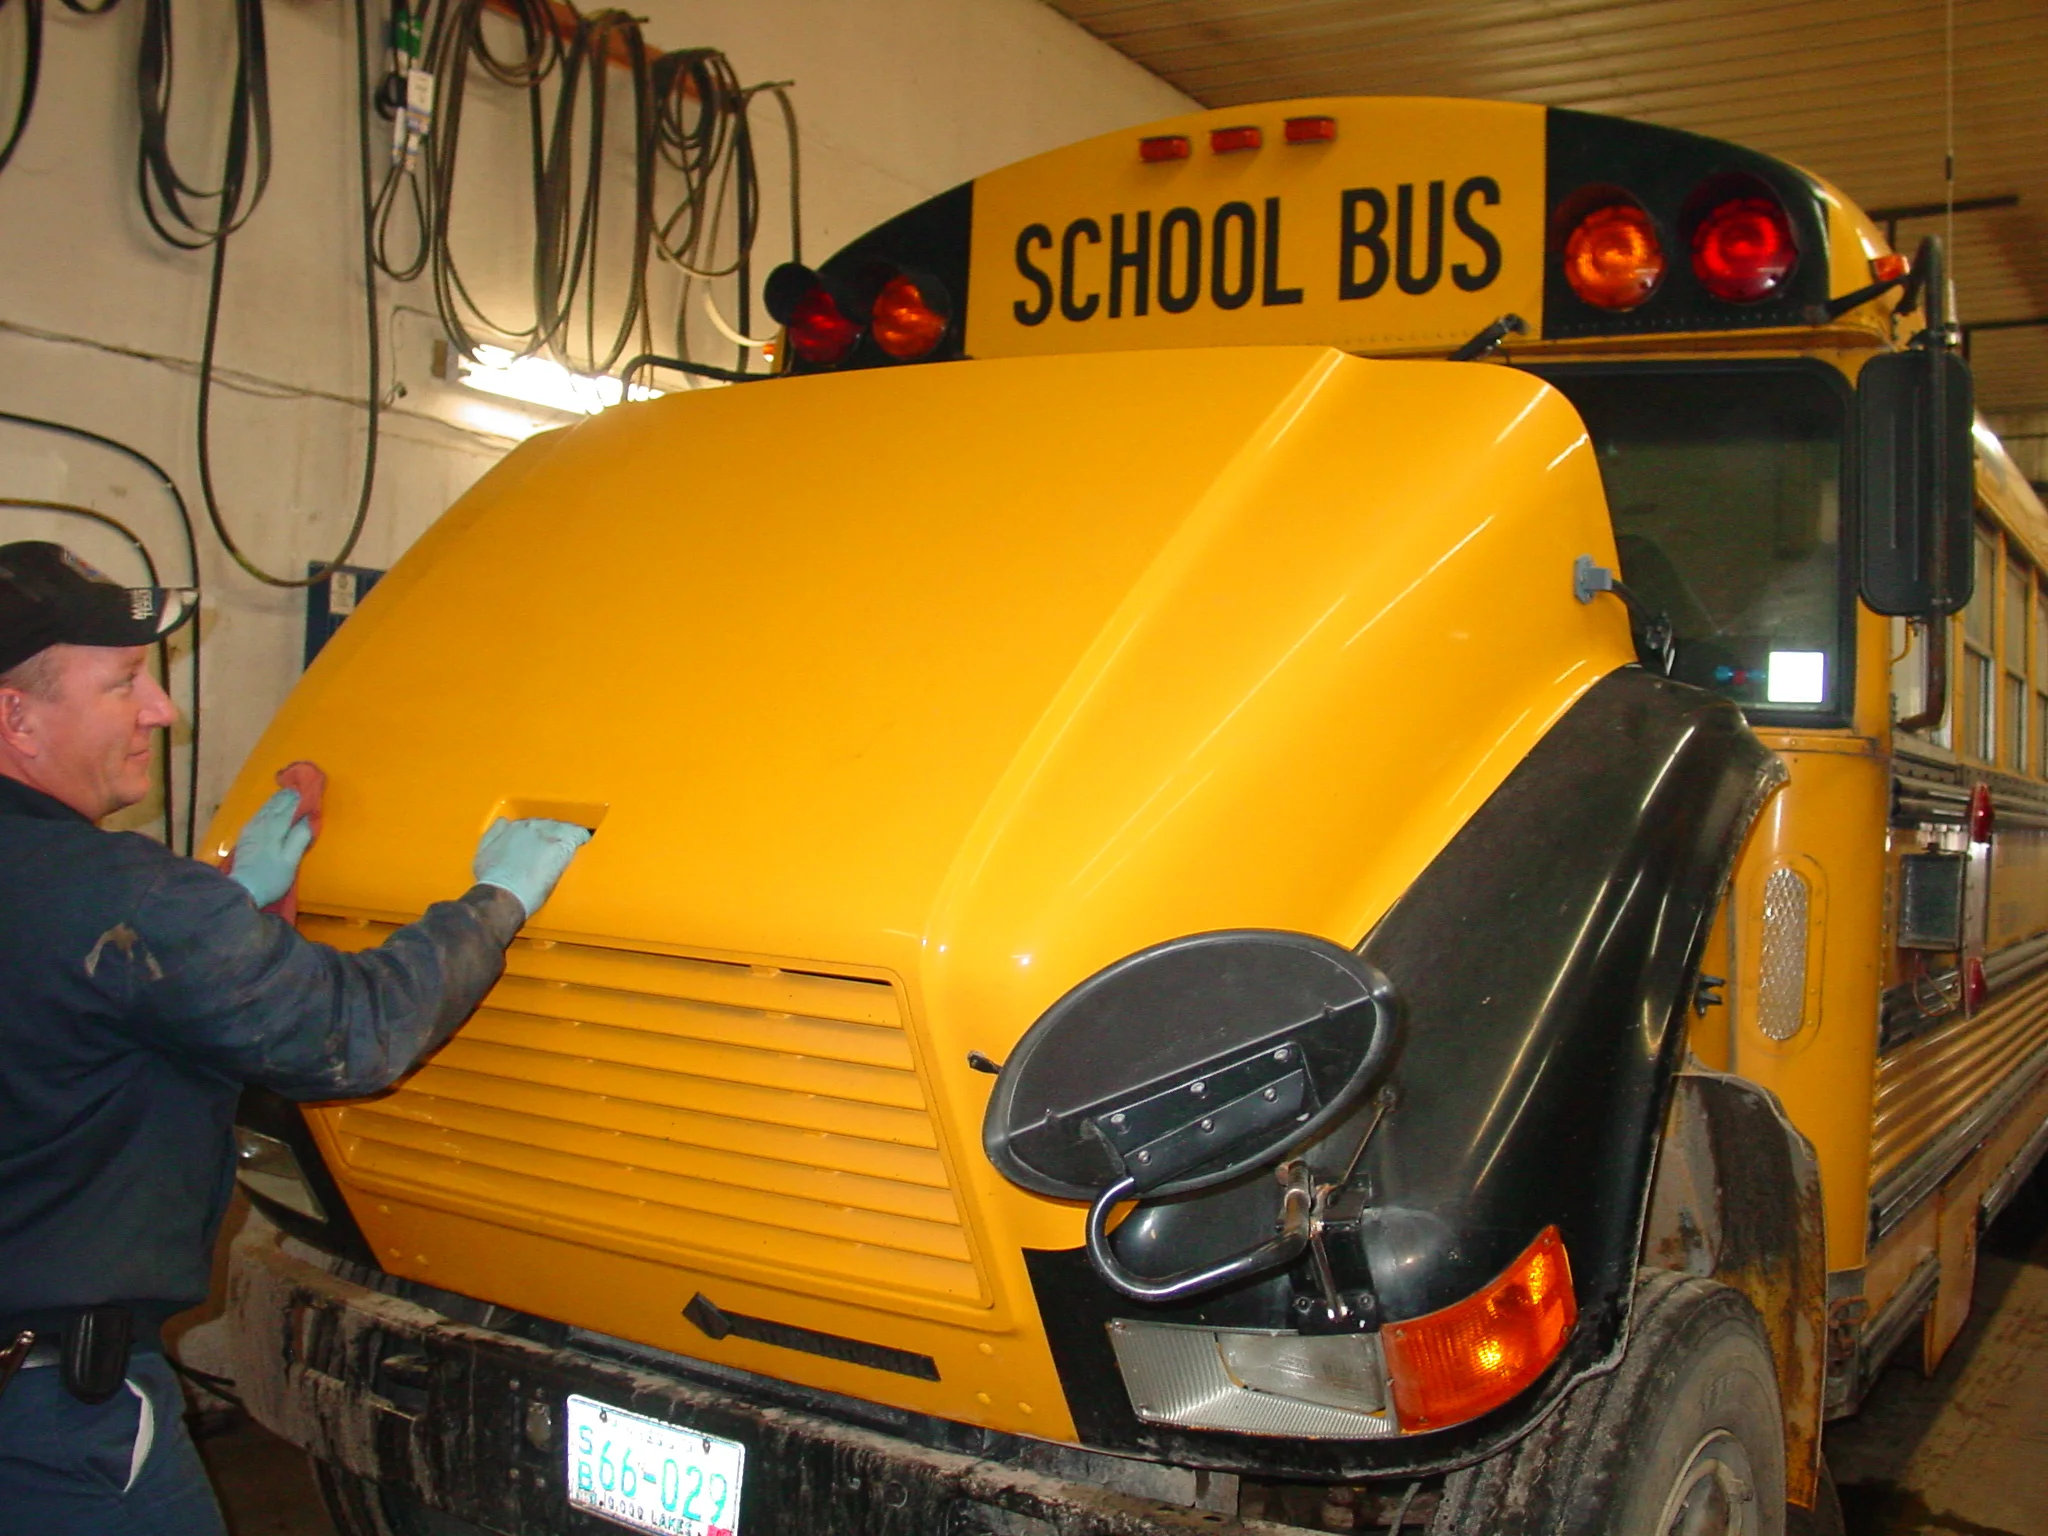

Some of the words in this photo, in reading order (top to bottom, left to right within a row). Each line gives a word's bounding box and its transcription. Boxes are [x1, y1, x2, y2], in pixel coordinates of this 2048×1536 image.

[1014, 197, 1304, 327] SCHOOL
[1339, 176, 1502, 301] BUS
[598, 1440, 728, 1525] 66-029
[650, 1509, 694, 1536] LAKES
